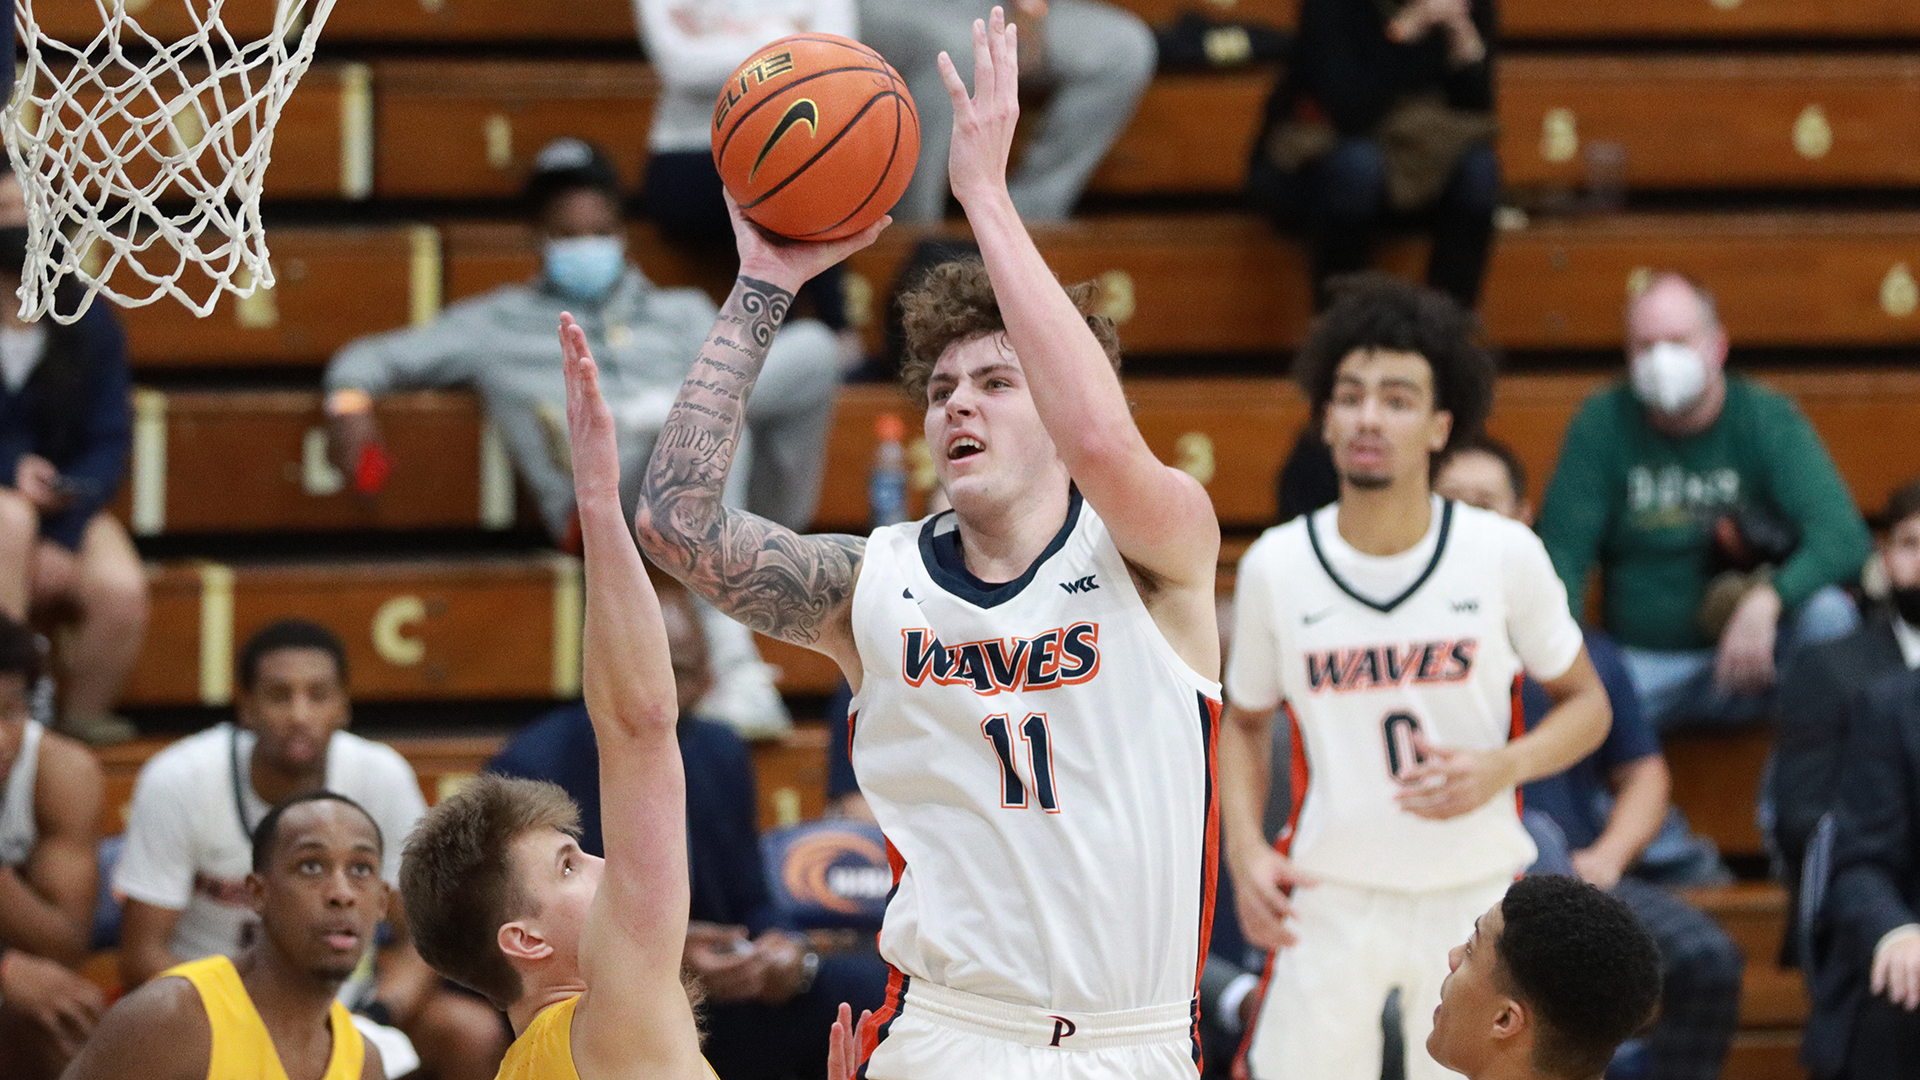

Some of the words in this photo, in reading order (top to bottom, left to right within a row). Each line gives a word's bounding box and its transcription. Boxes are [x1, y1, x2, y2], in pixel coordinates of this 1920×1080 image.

[715, 51, 795, 132] ELITE
[1059, 574, 1101, 595] WCC
[372, 596, 426, 667] C
[901, 621, 1101, 697] WAVES
[1304, 637, 1480, 694] WAVES
[980, 712, 1061, 814] 11
[1046, 1015, 1076, 1047] P
